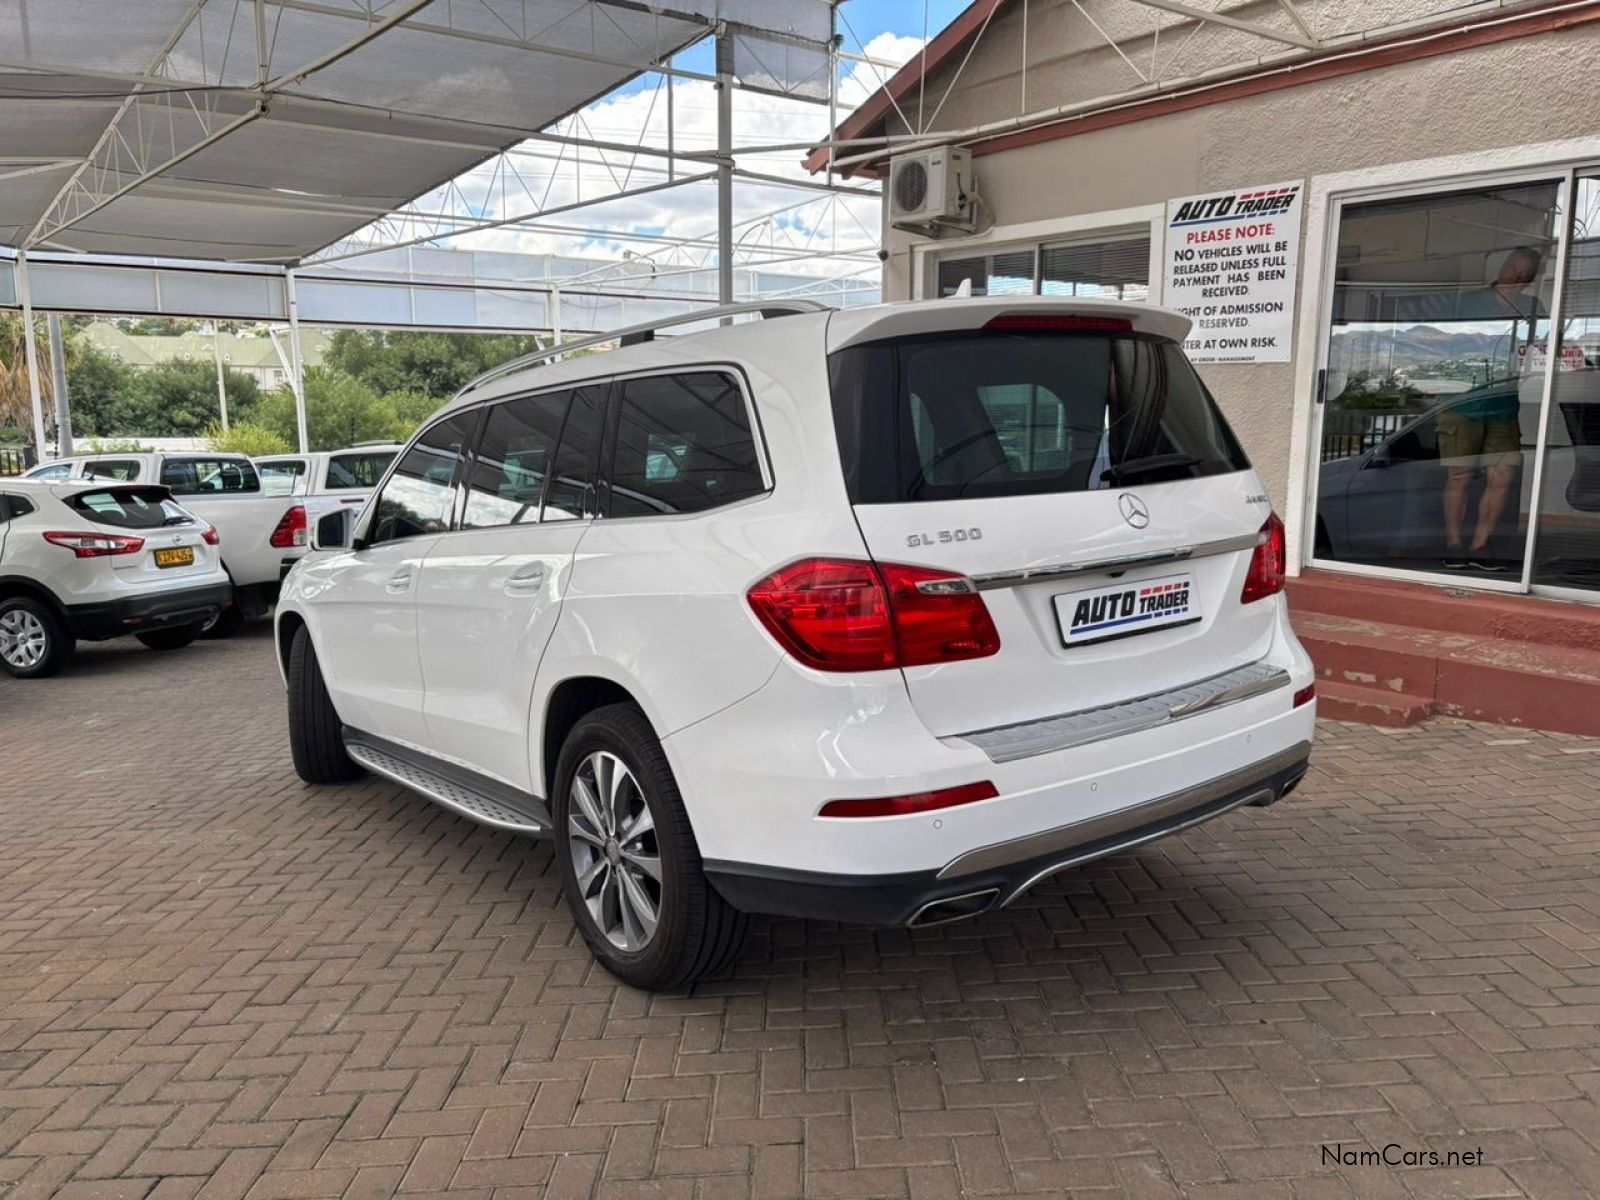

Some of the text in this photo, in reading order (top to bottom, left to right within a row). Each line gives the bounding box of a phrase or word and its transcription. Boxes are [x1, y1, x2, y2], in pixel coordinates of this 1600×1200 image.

[1172, 193, 1296, 222] AUTO TRADER
[1186, 223, 1275, 244] PLEASE NOTE:
[1174, 240, 1288, 262] NO VEHICLES WILL BE
[1173, 255, 1286, 276] RELEASED UNLESS FULL
[1173, 269, 1286, 288] PAYMENT HAS BEEN
[1202, 285, 1250, 298] RECEIVED.
[1203, 305, 1217, 316] OF
[1219, 301, 1284, 315] ADMISSION
[1199, 317, 1250, 329] RESERVED.
[1203, 339, 1217, 349] AT
[1219, 338, 1248, 349] OWN
[1250, 336, 1278, 348] RISK.
[905, 528, 982, 547] GL 500
[1071, 589, 1189, 627] AUTO TRADER
